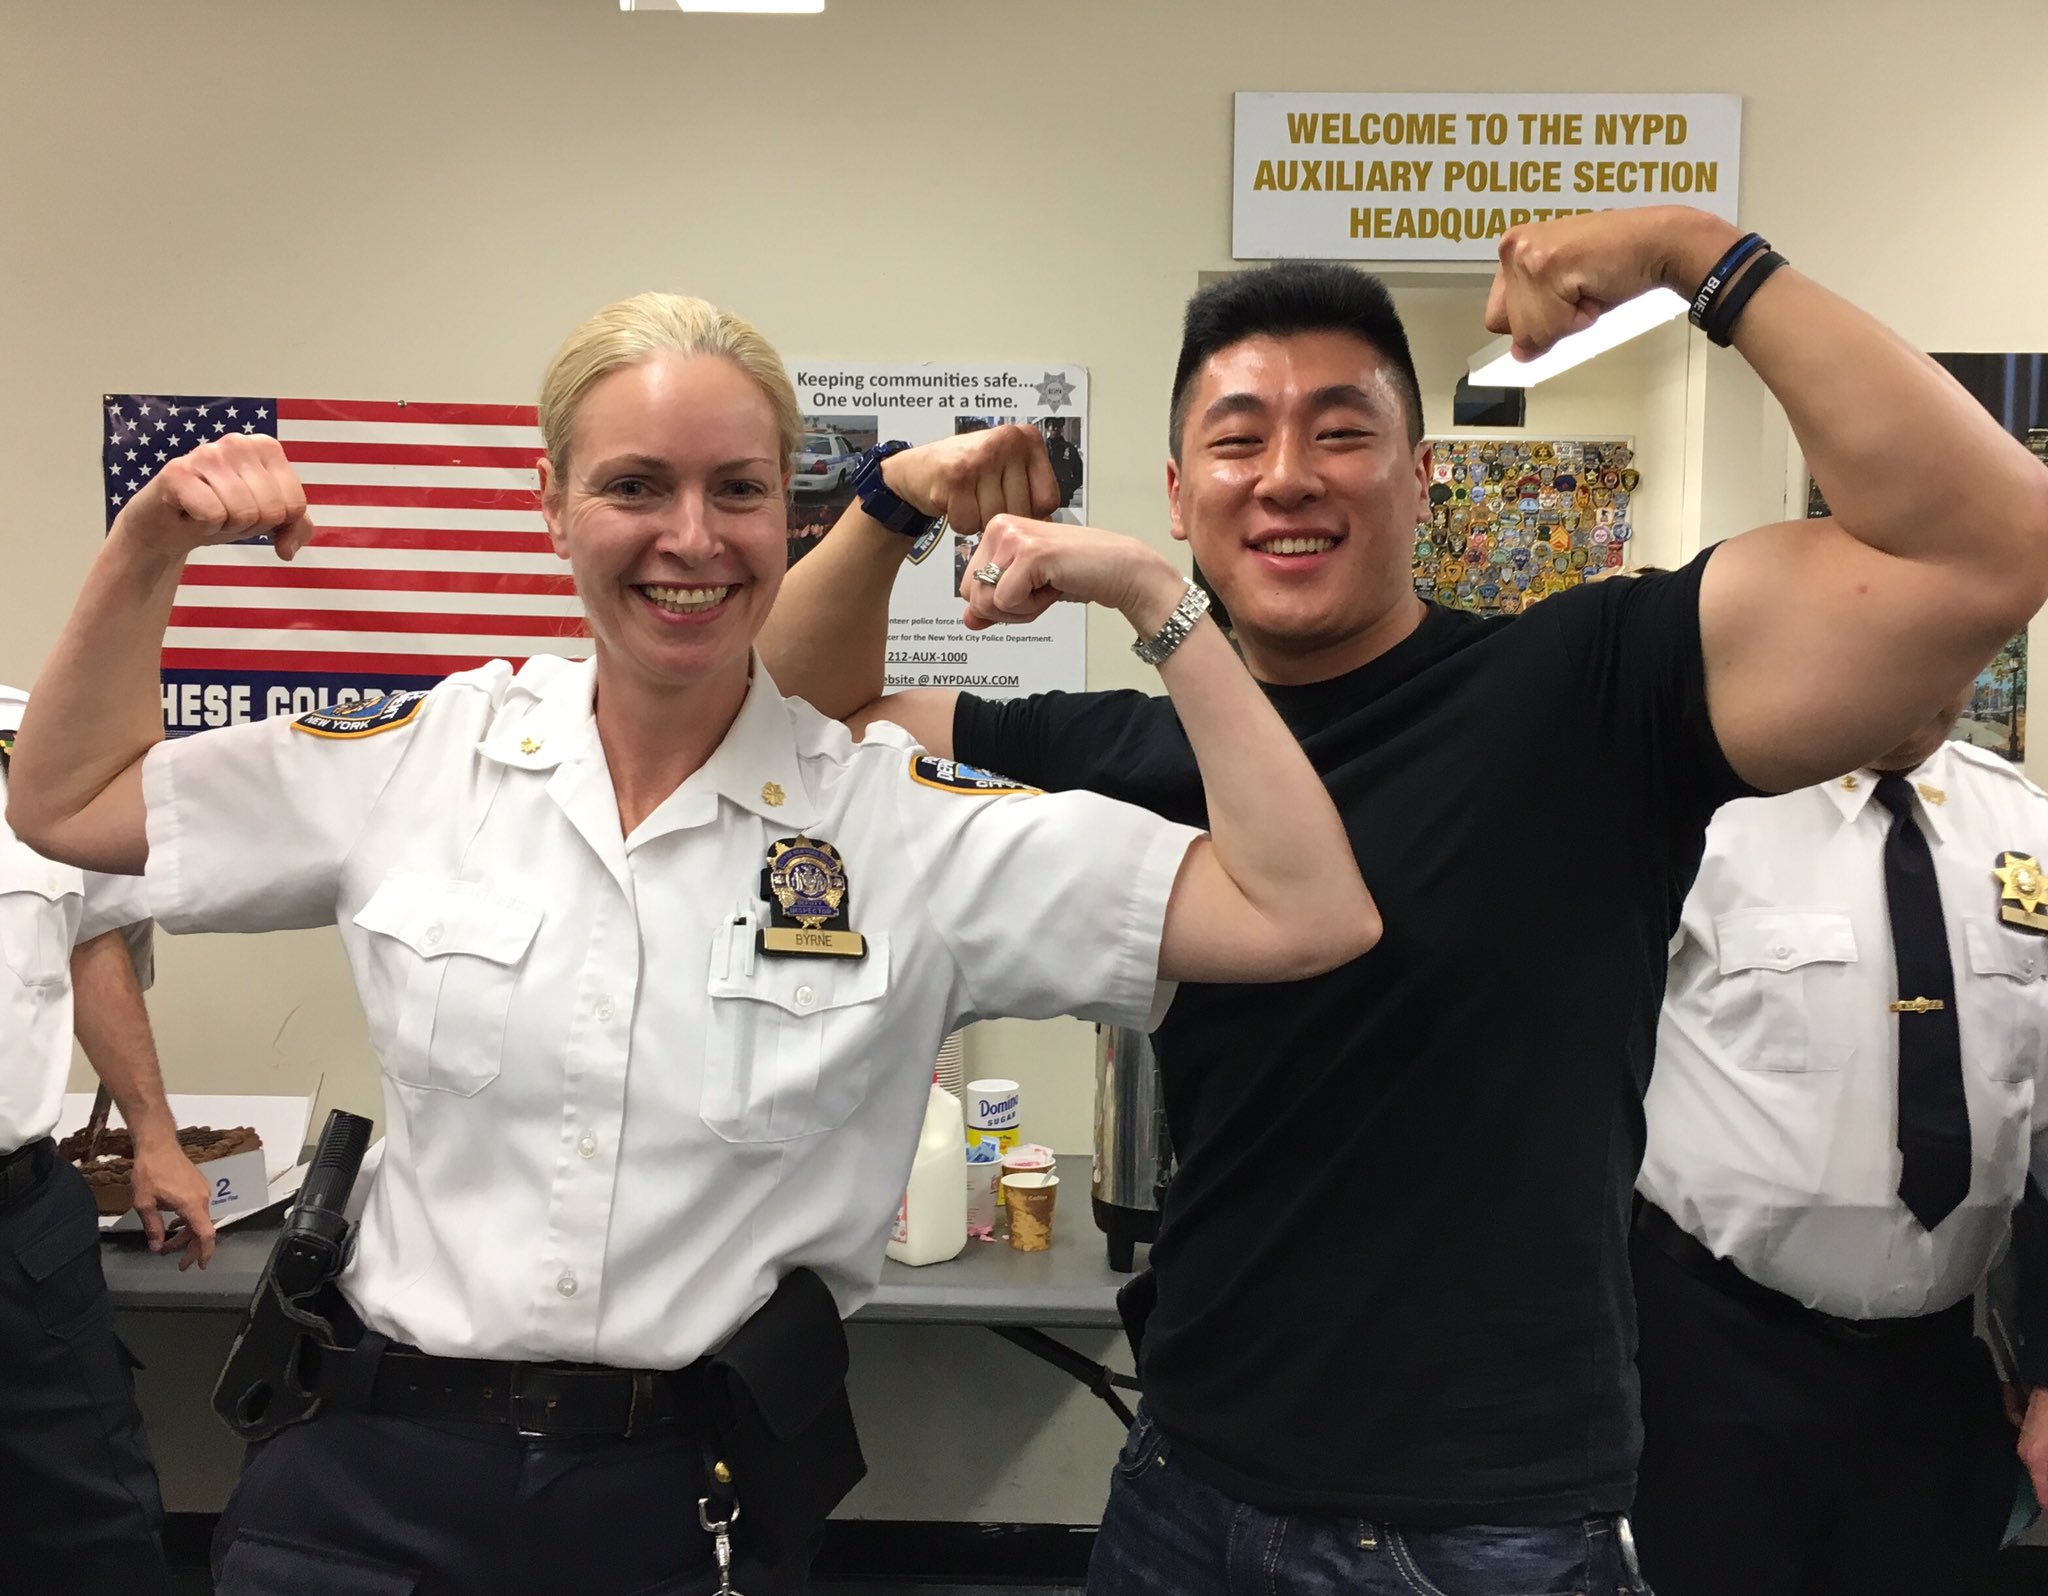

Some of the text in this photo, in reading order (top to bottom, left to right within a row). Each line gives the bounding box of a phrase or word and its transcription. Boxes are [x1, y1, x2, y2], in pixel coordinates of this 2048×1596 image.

[1286, 112, 1688, 146] WELCOME TO THE NYPD
[1253, 159, 1718, 193] AUXILIARY POLICE SECTION
[1693, 275, 1721, 314] BLUE
[797, 371, 1034, 390] Keeping communities safe...
[812, 392, 1018, 408] One volunteer at a time.
[911, 616, 934, 626] police
[935, 617, 955, 625] force
[901, 633, 912, 641] for
[928, 634, 945, 642] New
[947, 634, 964, 642] York
[965, 634, 979, 643] City
[981, 634, 1004, 642] Police
[1005, 635, 1054, 643] Department.
[888, 651, 968, 662] 212-AUX-1000
[918, 675, 929, 686] @
[933, 675, 1019, 685] NYPDAUX.COM
[304, 715, 371, 730] NEW YORK
[795, 933, 832, 947] BYRNE
[987, 1111, 1016, 1126] SUGAR
[216, 1177, 231, 1197] 2
